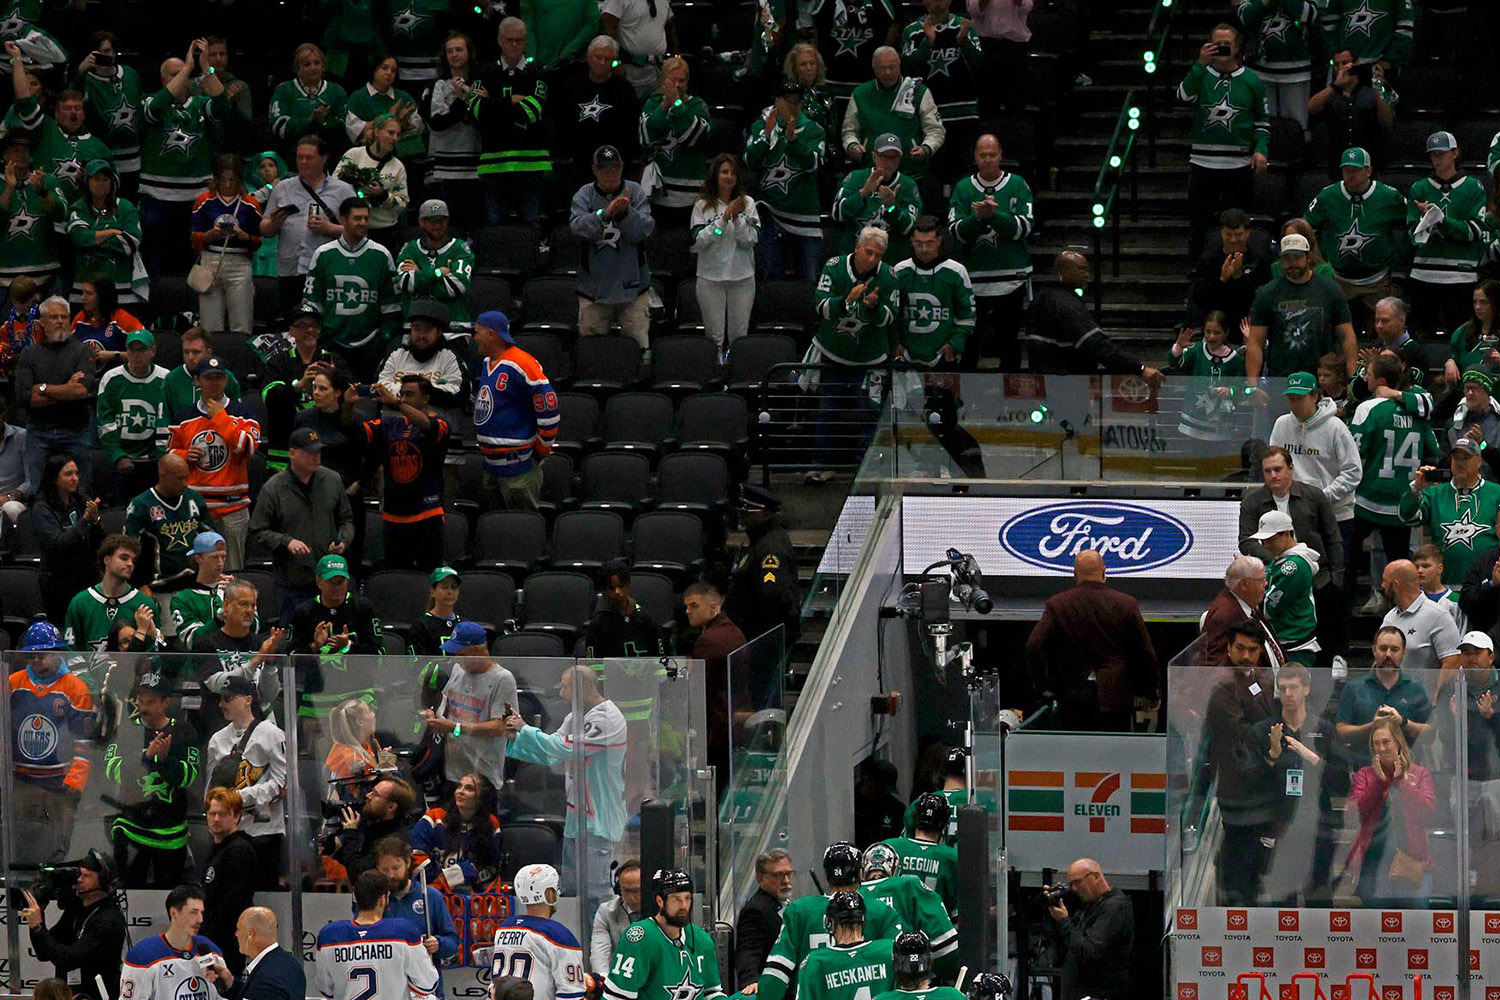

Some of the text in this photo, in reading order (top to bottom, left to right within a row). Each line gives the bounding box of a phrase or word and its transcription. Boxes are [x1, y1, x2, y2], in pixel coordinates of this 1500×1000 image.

[496, 373, 509, 391] C
[533, 392, 559, 413] 99
[1393, 412, 1414, 430] BENN
[1283, 443, 1320, 457] Wilson
[1378, 430, 1422, 480] 14
[188, 499, 200, 518] A
[160, 520, 200, 536] STARS
[1037, 511, 1154, 562] Ford
[834, 868, 843, 876] 24
[902, 855, 940, 874] SEGUIN
[497, 930, 528, 946] PERRY
[334, 944, 394, 963] BOUCHARD
[910, 953, 919, 962] 22
[565, 964, 584, 983] 90
[611, 952, 636, 979] 14
[825, 963, 888, 990] HEISKANEN
[994, 992, 1004, 1000] 64
